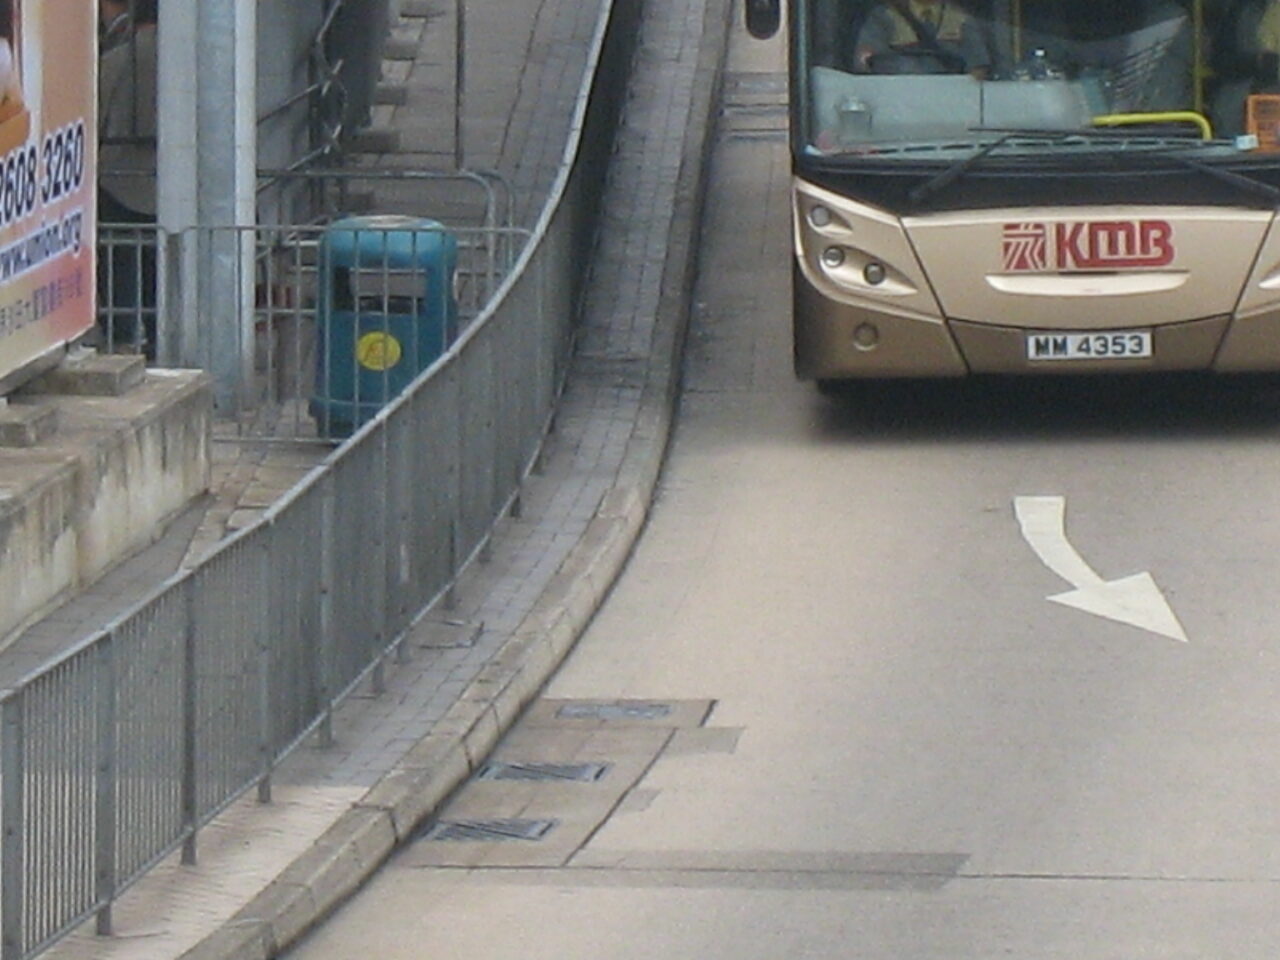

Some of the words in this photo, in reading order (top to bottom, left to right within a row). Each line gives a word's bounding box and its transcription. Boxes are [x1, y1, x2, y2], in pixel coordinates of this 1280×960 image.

[42, 122, 84, 204] 3260
[1056, 220, 1174, 269] KMB
[1077, 335, 1144, 355] 4353
